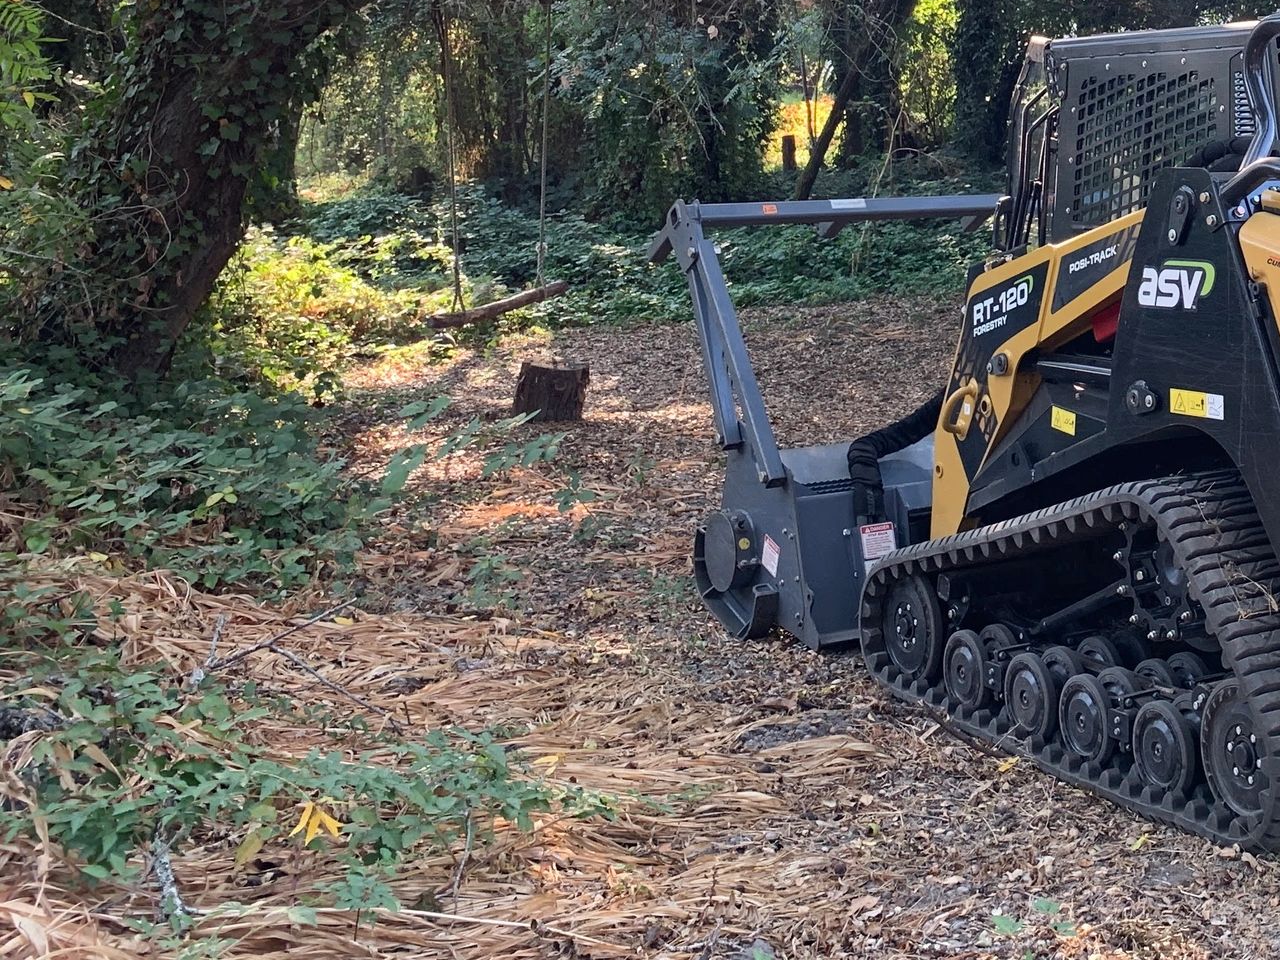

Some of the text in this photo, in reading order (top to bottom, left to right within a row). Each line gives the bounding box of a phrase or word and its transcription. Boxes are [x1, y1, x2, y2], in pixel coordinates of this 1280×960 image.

[1069, 244, 1117, 274] POSI-TRACK
[973, 281, 1028, 326] RT-120
[973, 315, 1008, 337] FORESTRY
